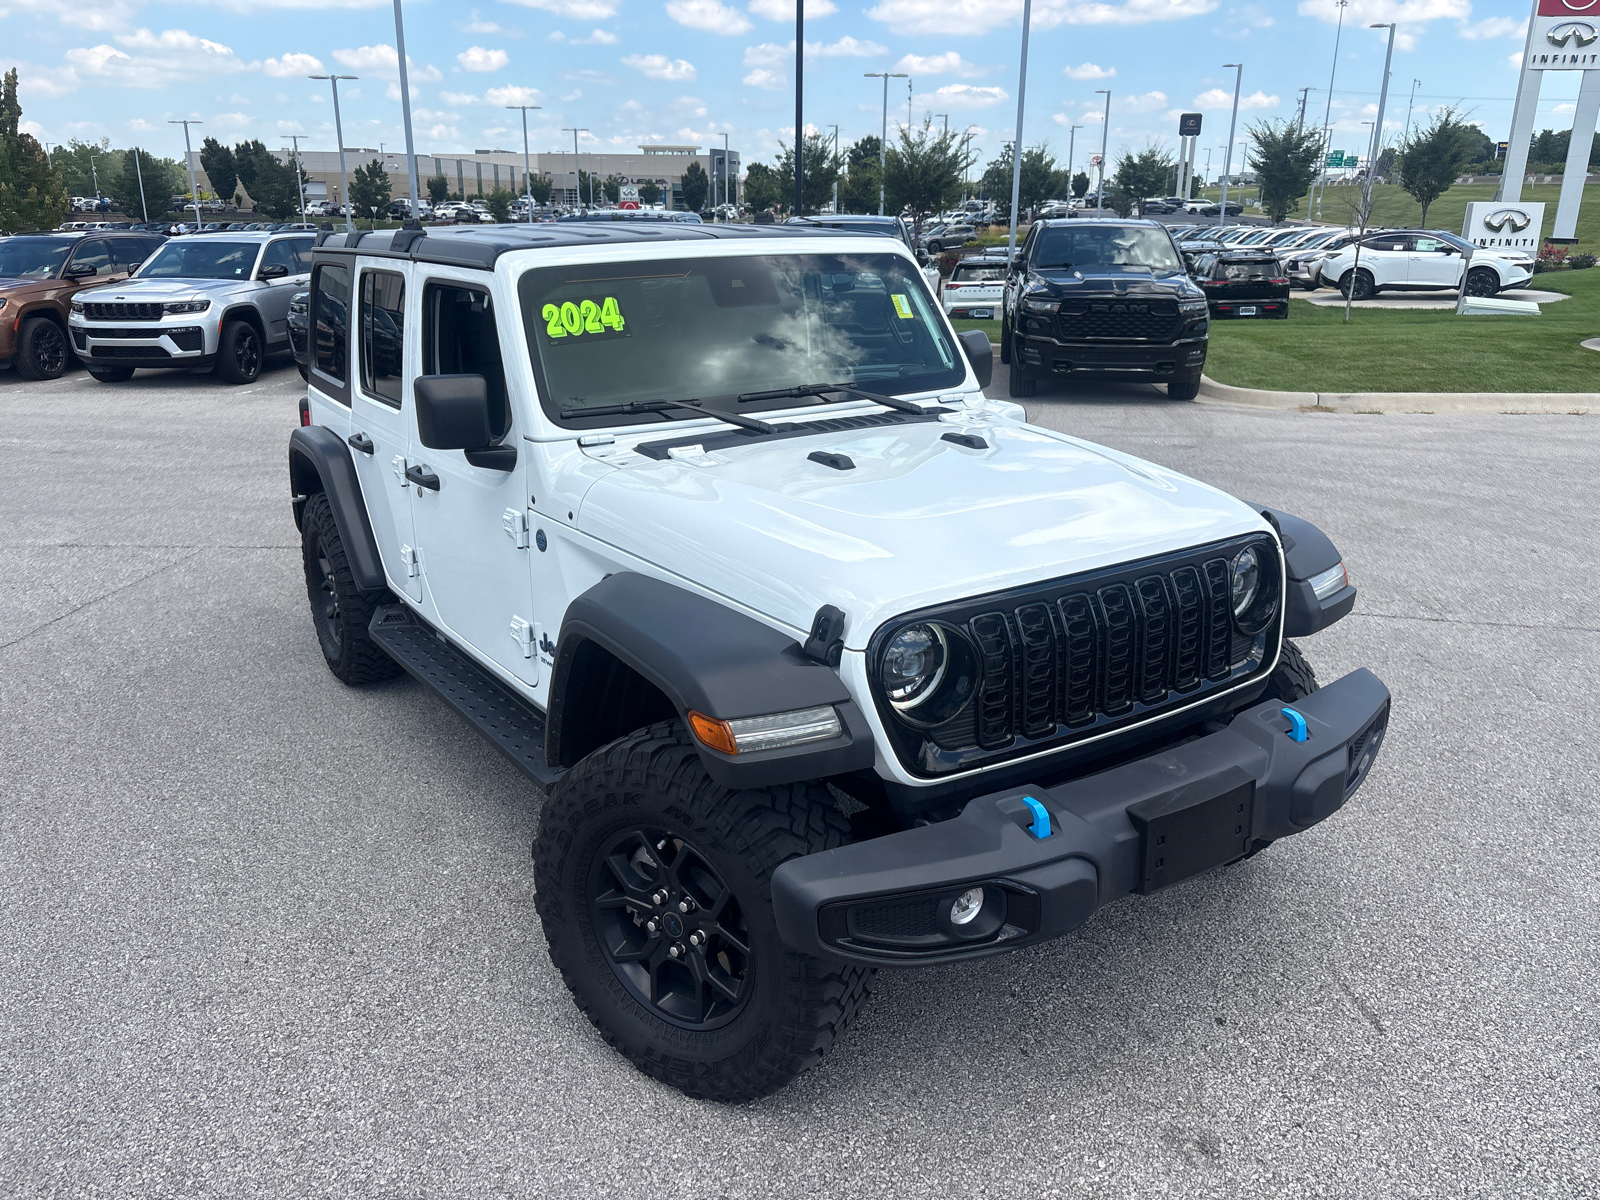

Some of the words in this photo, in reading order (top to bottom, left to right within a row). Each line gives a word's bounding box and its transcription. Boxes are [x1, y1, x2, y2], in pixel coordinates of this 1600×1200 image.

[1532, 54, 1599, 64] INFINIT
[1473, 238, 1535, 246] INFINITI
[1091, 304, 1149, 313] RAM
[542, 296, 625, 338] 2024
